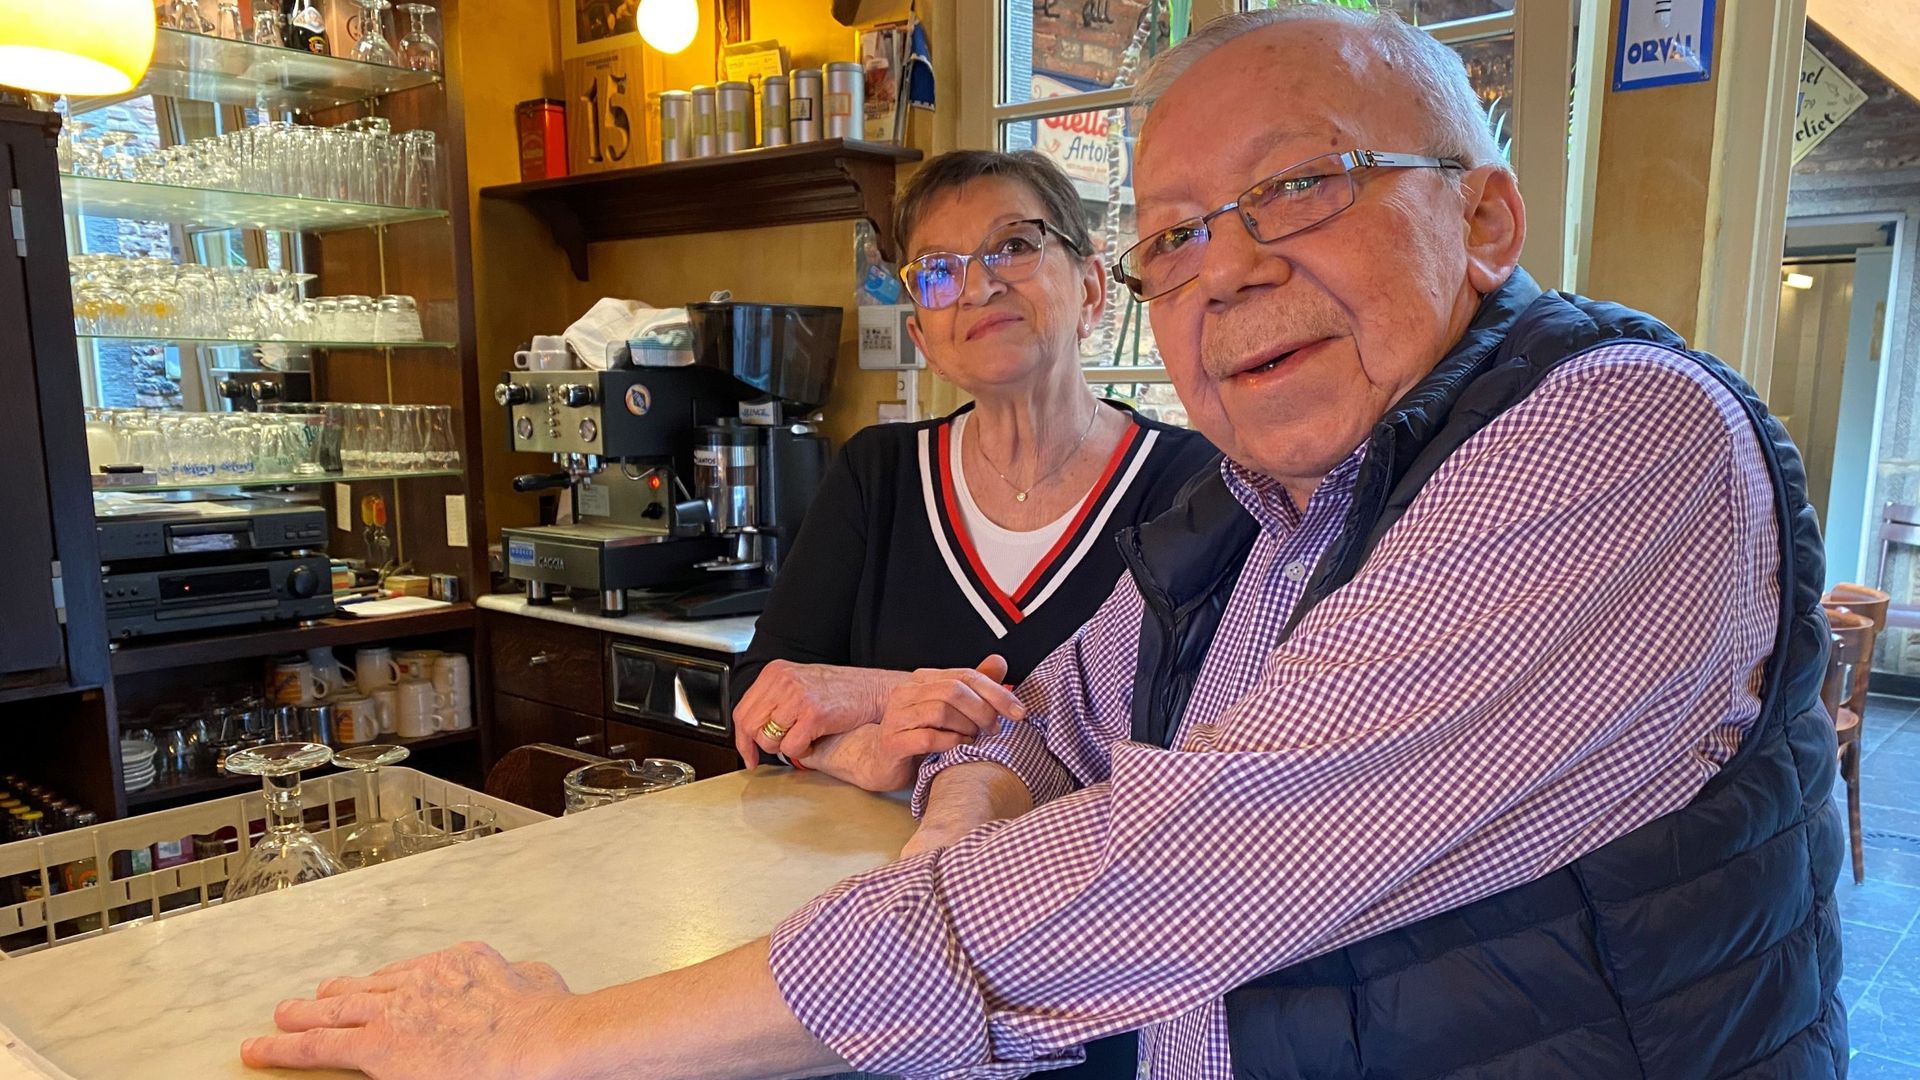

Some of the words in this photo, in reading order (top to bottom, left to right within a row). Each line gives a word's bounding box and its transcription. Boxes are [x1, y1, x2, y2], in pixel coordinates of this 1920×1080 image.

[1627, 32, 1696, 65] ORVAL
[580, 73, 631, 163] 15
[1063, 136, 1109, 163] Artoi
